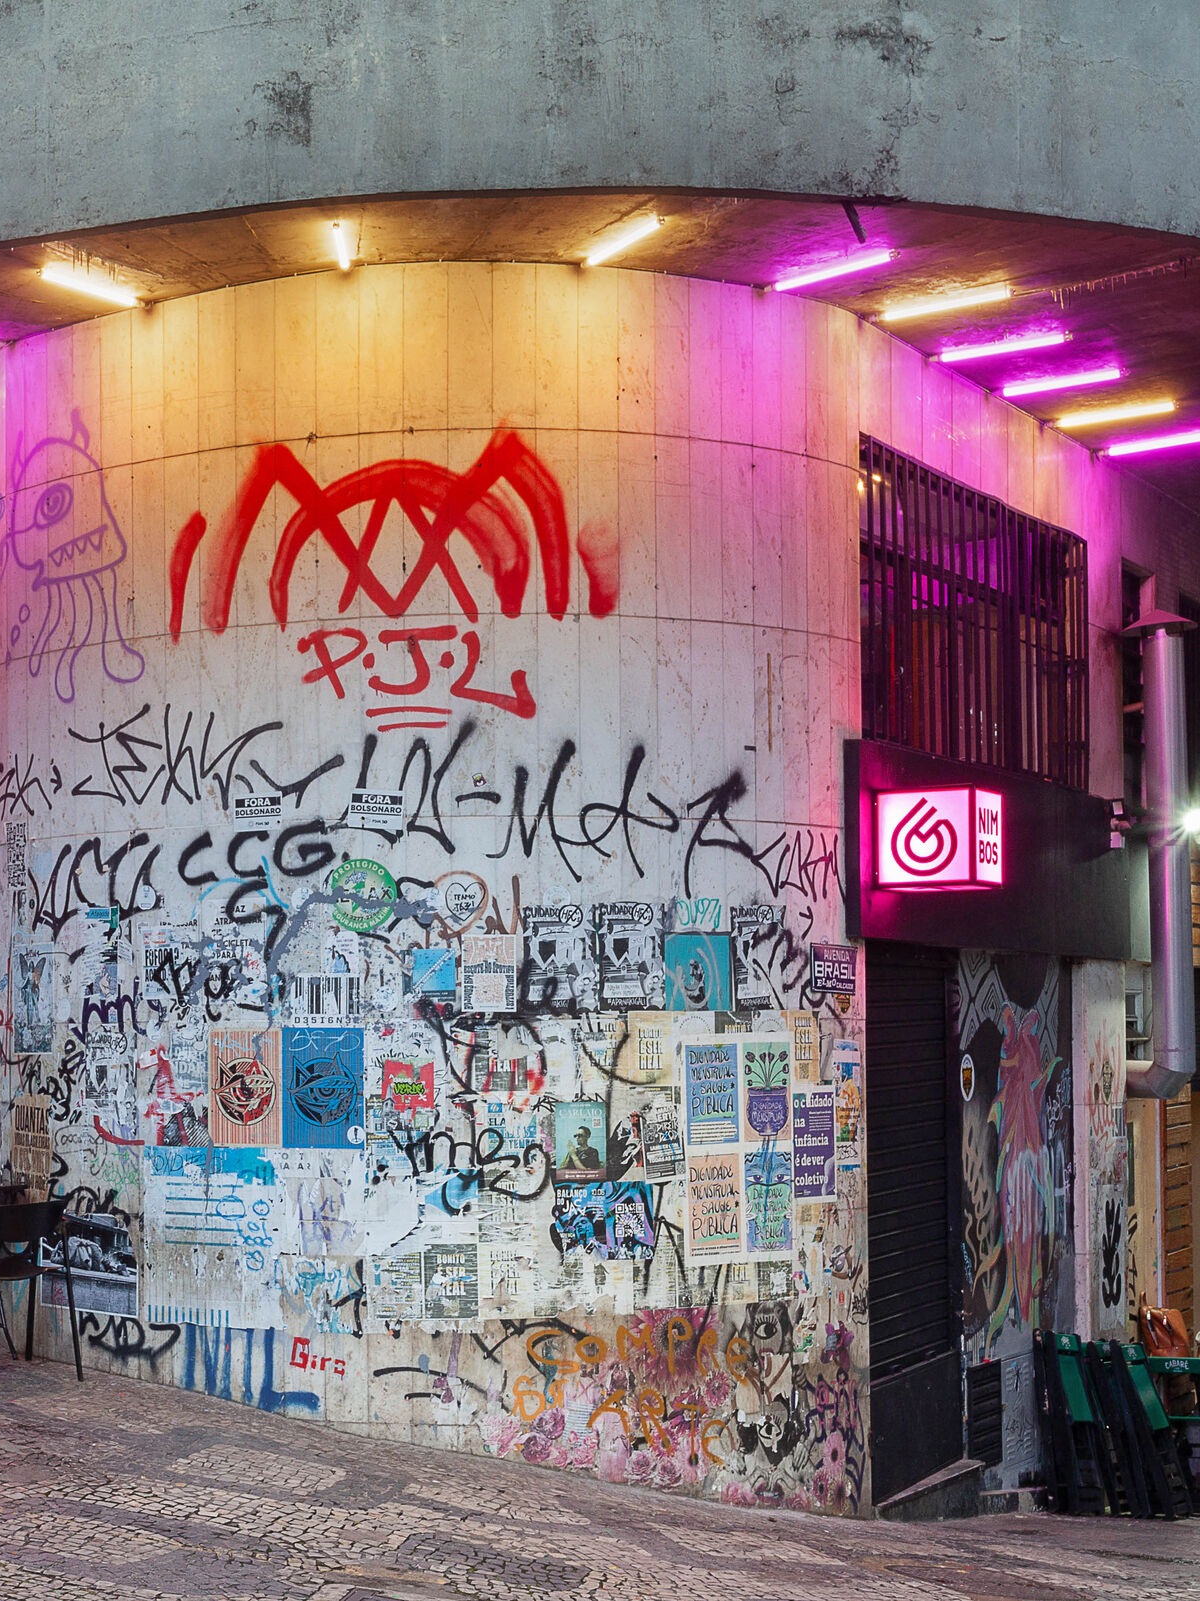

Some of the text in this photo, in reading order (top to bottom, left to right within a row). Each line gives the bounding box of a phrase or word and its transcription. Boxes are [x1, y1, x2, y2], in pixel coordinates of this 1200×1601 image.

[244, 798, 271, 807] FORA
[361, 795, 392, 804] FORA
[235, 808, 282, 816] BOLSONARO
[350, 804, 402, 814] BOLSONARO
[978, 807, 999, 836] NIM
[979, 843, 998, 865] BOS
[334, 860, 385, 879] PROTEGIDO
[523, 906, 560, 918] CUIDADO
[601, 903, 633, 916] CUIDADO
[731, 907, 758, 918] CUIDADO
[823, 949, 850, 962] AVENIDA
[814, 961, 856, 979] BRASIL
[817, 978, 836, 988] ELMO
[689, 1050, 730, 1065] DIGNIDADE
[794, 1117, 805, 1128] na
[794, 1133, 829, 1147] infância
[795, 1153, 825, 1166] é dever
[689, 1164, 734, 1182] DIGNIDADE
[794, 1172, 829, 1186] coletivo
[556, 1198, 565, 1206] DO
[437, 1254, 465, 1264] BONITO
[526, 1315, 751, 1387] COMPRE
[587, 1389, 733, 1467] ARTE
